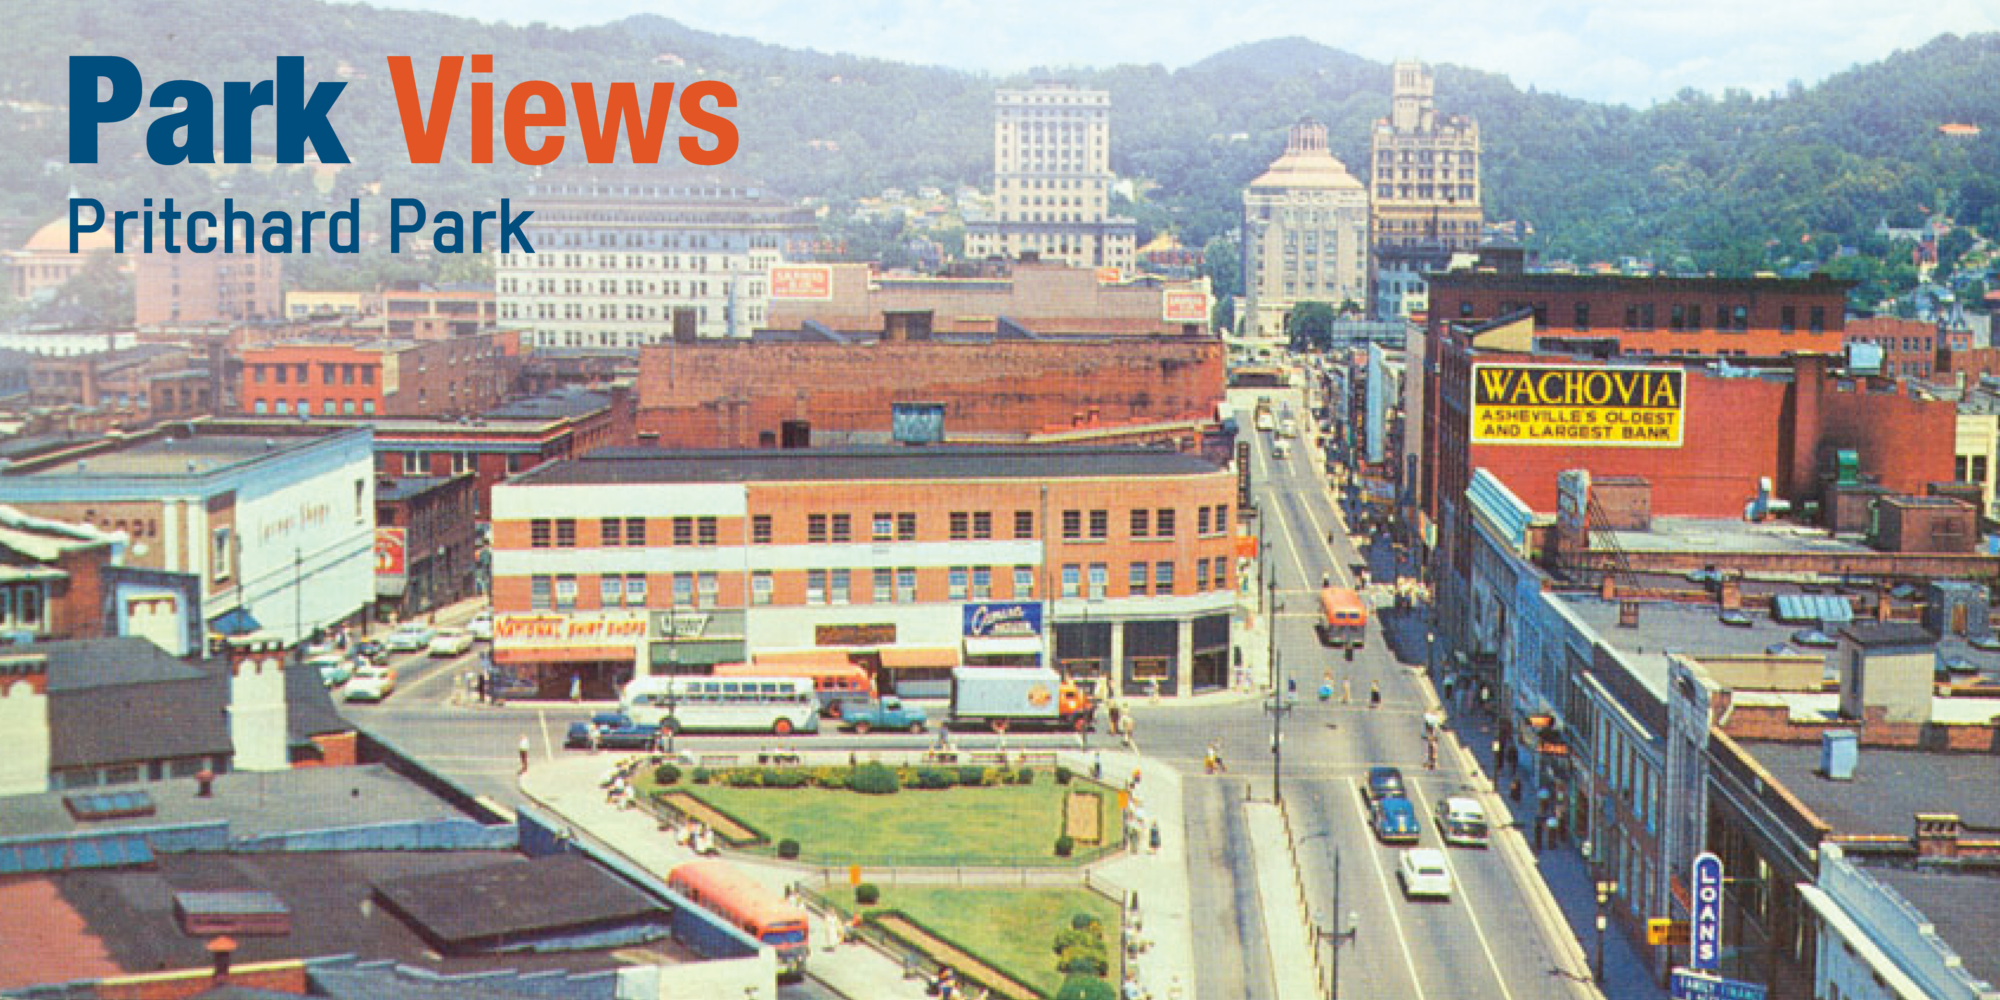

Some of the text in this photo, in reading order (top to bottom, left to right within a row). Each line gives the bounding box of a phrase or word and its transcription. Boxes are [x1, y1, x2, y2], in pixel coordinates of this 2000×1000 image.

[1479, 369, 1678, 406] WACHOVIA
[1481, 409, 1675, 425] ASHEVILLE'S OLDEST
[1484, 424, 1671, 439] AND LARGEST BANK
[1700, 865, 1717, 961] LOANS
